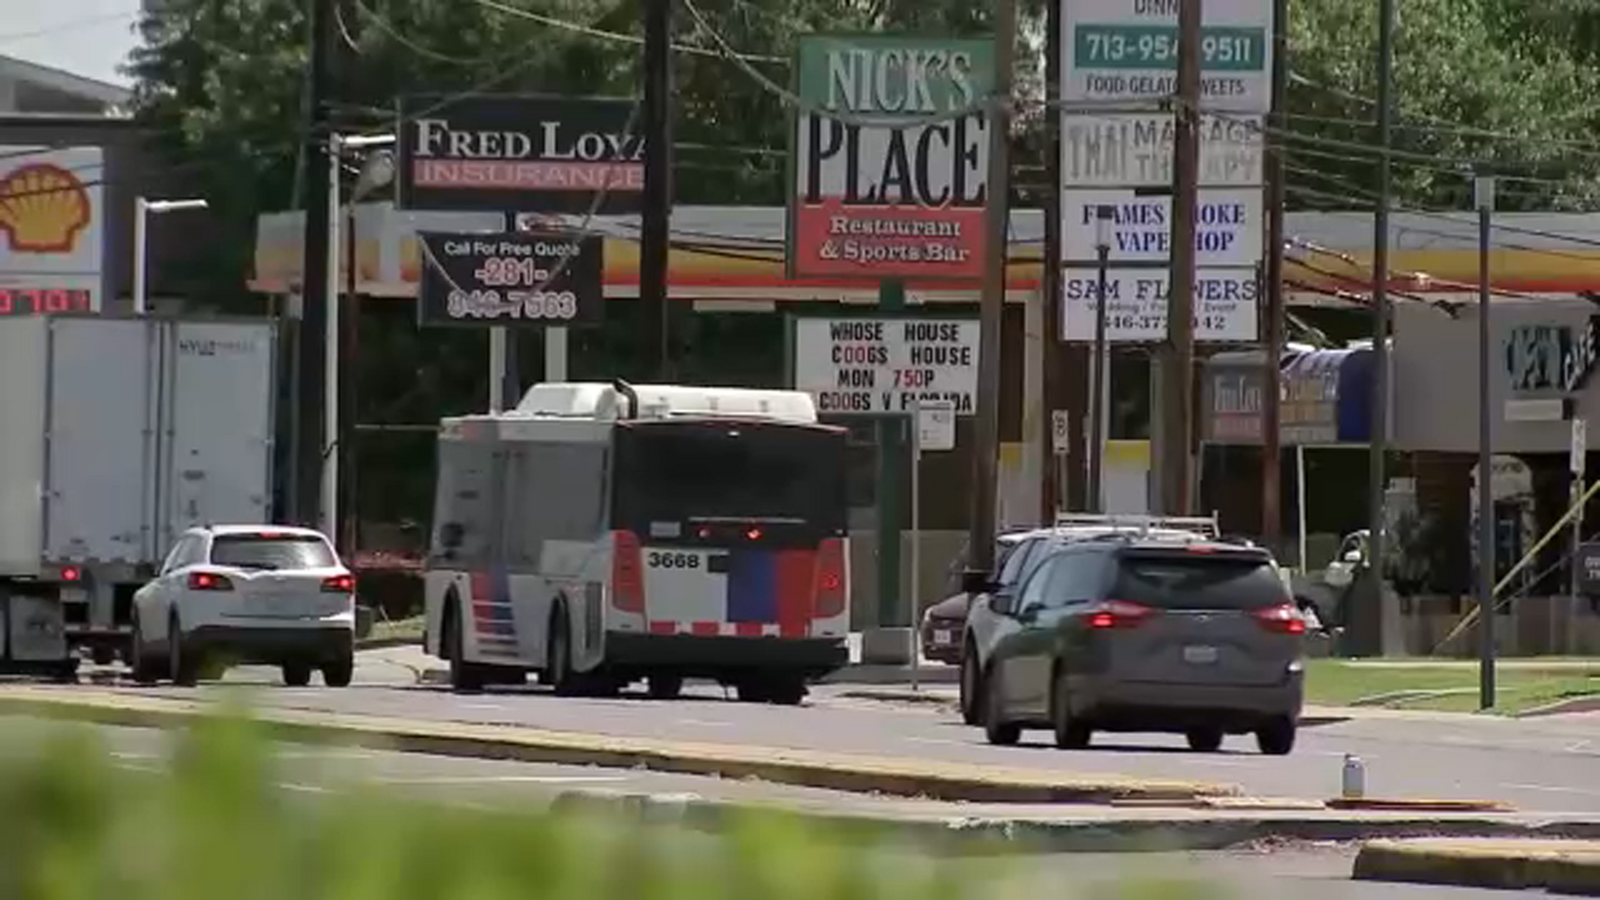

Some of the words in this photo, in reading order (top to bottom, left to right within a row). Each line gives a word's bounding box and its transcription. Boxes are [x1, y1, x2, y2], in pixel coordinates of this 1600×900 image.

[1134, 0, 1179, 15] DINN
[1087, 34, 1251, 61] 713-959511
[827, 49, 974, 110] NICK'S
[1087, 74, 1123, 93] FOOD
[1200, 78, 1246, 95] WEETS
[414, 119, 531, 158] FRED
[1134, 119, 1259, 147] MAAGE
[805, 110, 987, 208] PLACE
[422, 163, 644, 187] INSURANCE
[1083, 204, 1164, 224] FAMES
[1193, 204, 1246, 224] OKE
[830, 216, 961, 236] Restaurant
[444, 242, 470, 256] Call
[474, 242, 496, 256] For
[500, 242, 532, 256] Free
[820, 240, 838, 259] &
[844, 241, 920, 263] Sports
[925, 244, 970, 262] Bar
[1116, 232, 1169, 251] VAPE
[1195, 232, 1234, 251] OP
[1067, 279, 1119, 299] SAM
[1136, 279, 1257, 299] FLERS
[830, 322, 884, 341] WHOSE
[904, 323, 960, 342] HOUSE
[832, 346, 888, 364] COOGS
[911, 347, 971, 365] HOUSE
[837, 369, 875, 387] MON
[894, 370, 935, 387] 750P
[820, 392, 871, 410] COOGS
[882, 392, 891, 410] V
[649, 552, 700, 568] 3668
